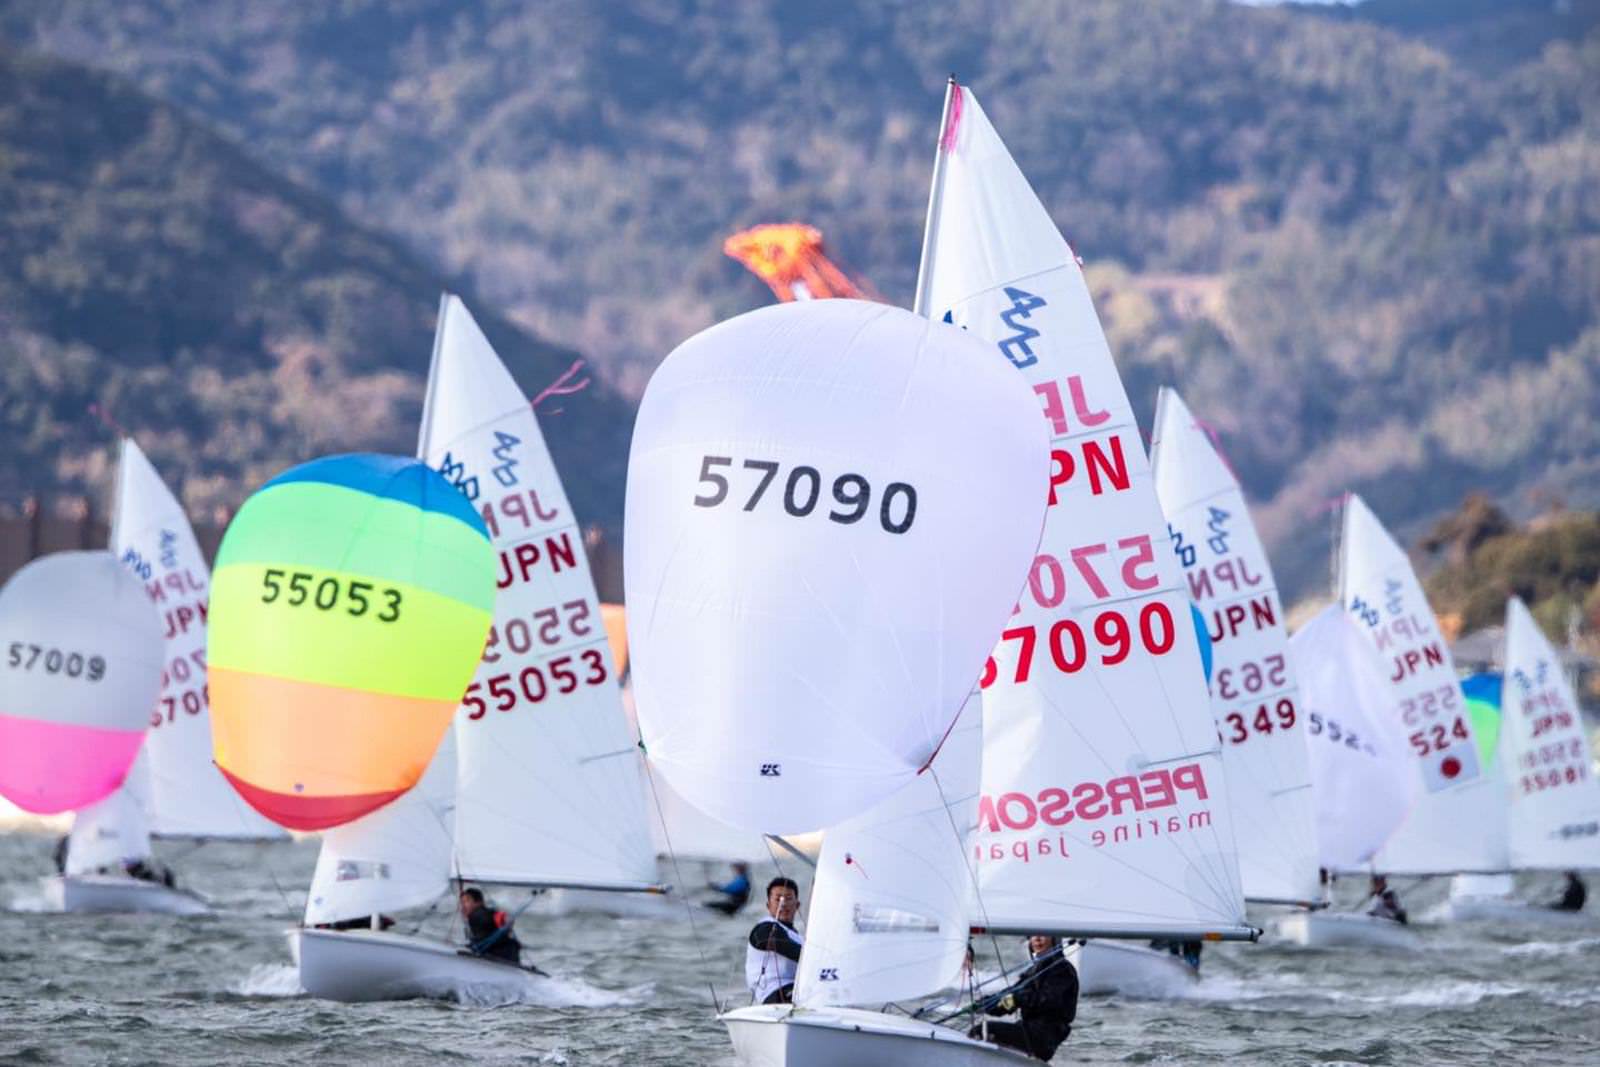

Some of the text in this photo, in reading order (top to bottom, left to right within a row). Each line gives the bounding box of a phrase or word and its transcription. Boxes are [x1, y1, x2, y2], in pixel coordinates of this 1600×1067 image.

[693, 455, 917, 534] 57090
[497, 533, 577, 589] JPN
[262, 569, 402, 622] 55053
[1209, 596, 1276, 643] JPN
[8, 642, 106, 682] 57009
[461, 649, 608, 721] 55053
[1391, 642, 1443, 682] JPN
[1216, 698, 1296, 743] 349
[1409, 716, 1469, 757] 524
